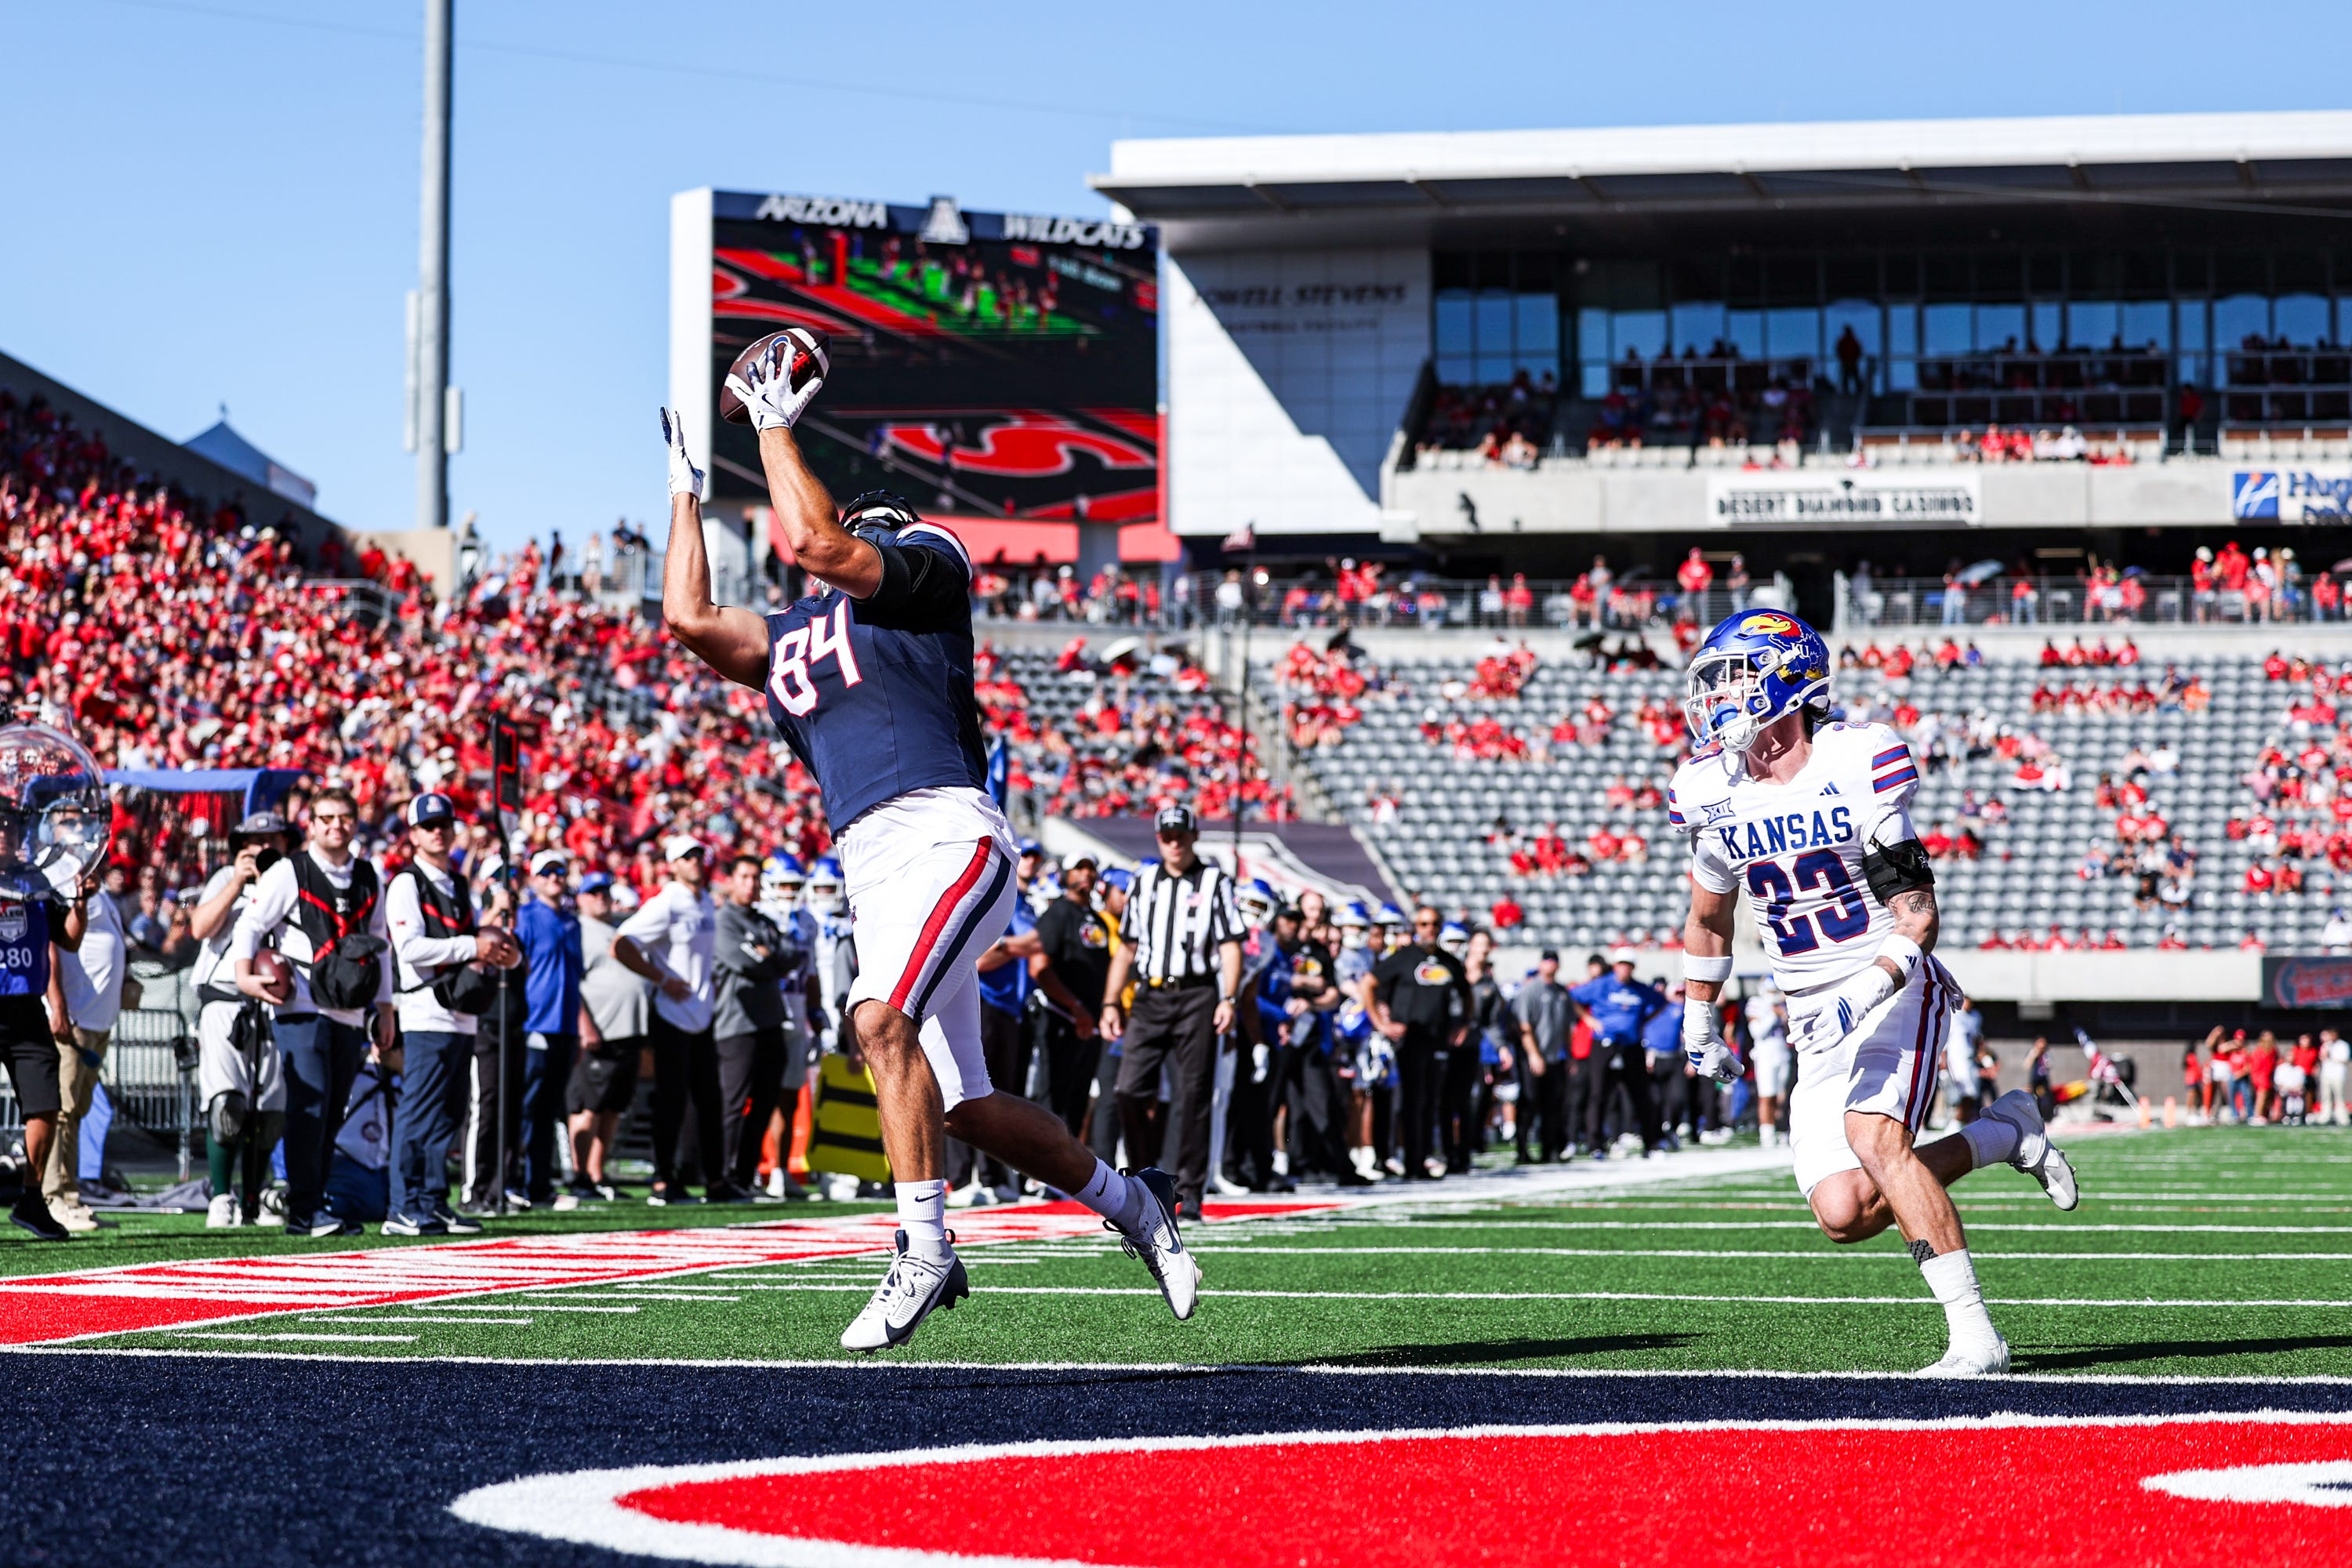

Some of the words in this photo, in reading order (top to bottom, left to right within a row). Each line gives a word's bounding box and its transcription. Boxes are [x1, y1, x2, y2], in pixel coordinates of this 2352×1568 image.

[756, 194, 888, 230] ARIZONA
[1000, 212, 1146, 251] WILDCATS
[1718, 497, 1787, 515] DESERT
[1797, 496, 1882, 514] DIAMOND
[1893, 495, 1973, 514] CASINOS
[769, 597, 862, 719] 84
[1790, 642, 1809, 659] KU
[1719, 806, 1853, 860] KANSAS
[1747, 848, 1871, 957] 23
